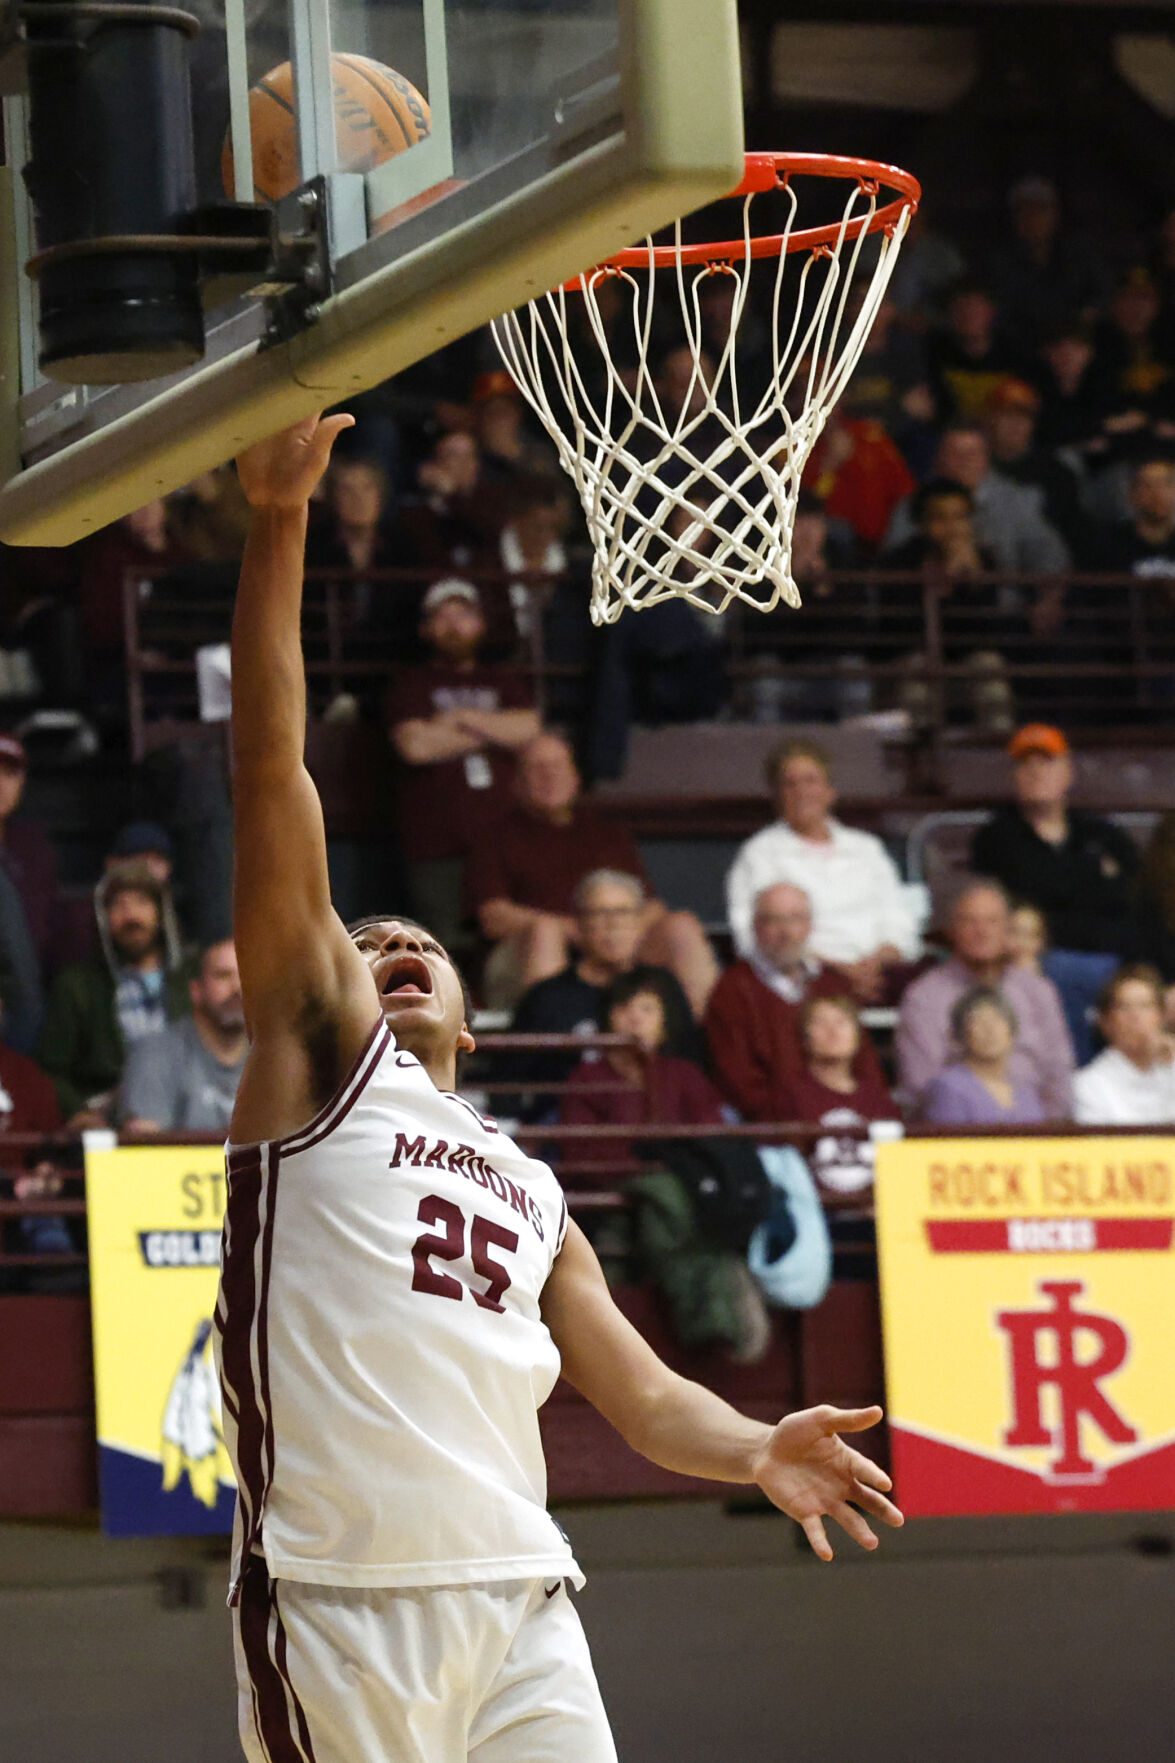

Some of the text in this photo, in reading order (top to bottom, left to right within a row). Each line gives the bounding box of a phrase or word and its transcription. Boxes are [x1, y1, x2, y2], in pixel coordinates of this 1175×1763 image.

[389, 1132, 545, 1243] MAROONS
[928, 1160, 1173, 1206] ROCK ISLAND
[145, 1232, 222, 1266] GOLD
[411, 1194, 519, 1314] 25
